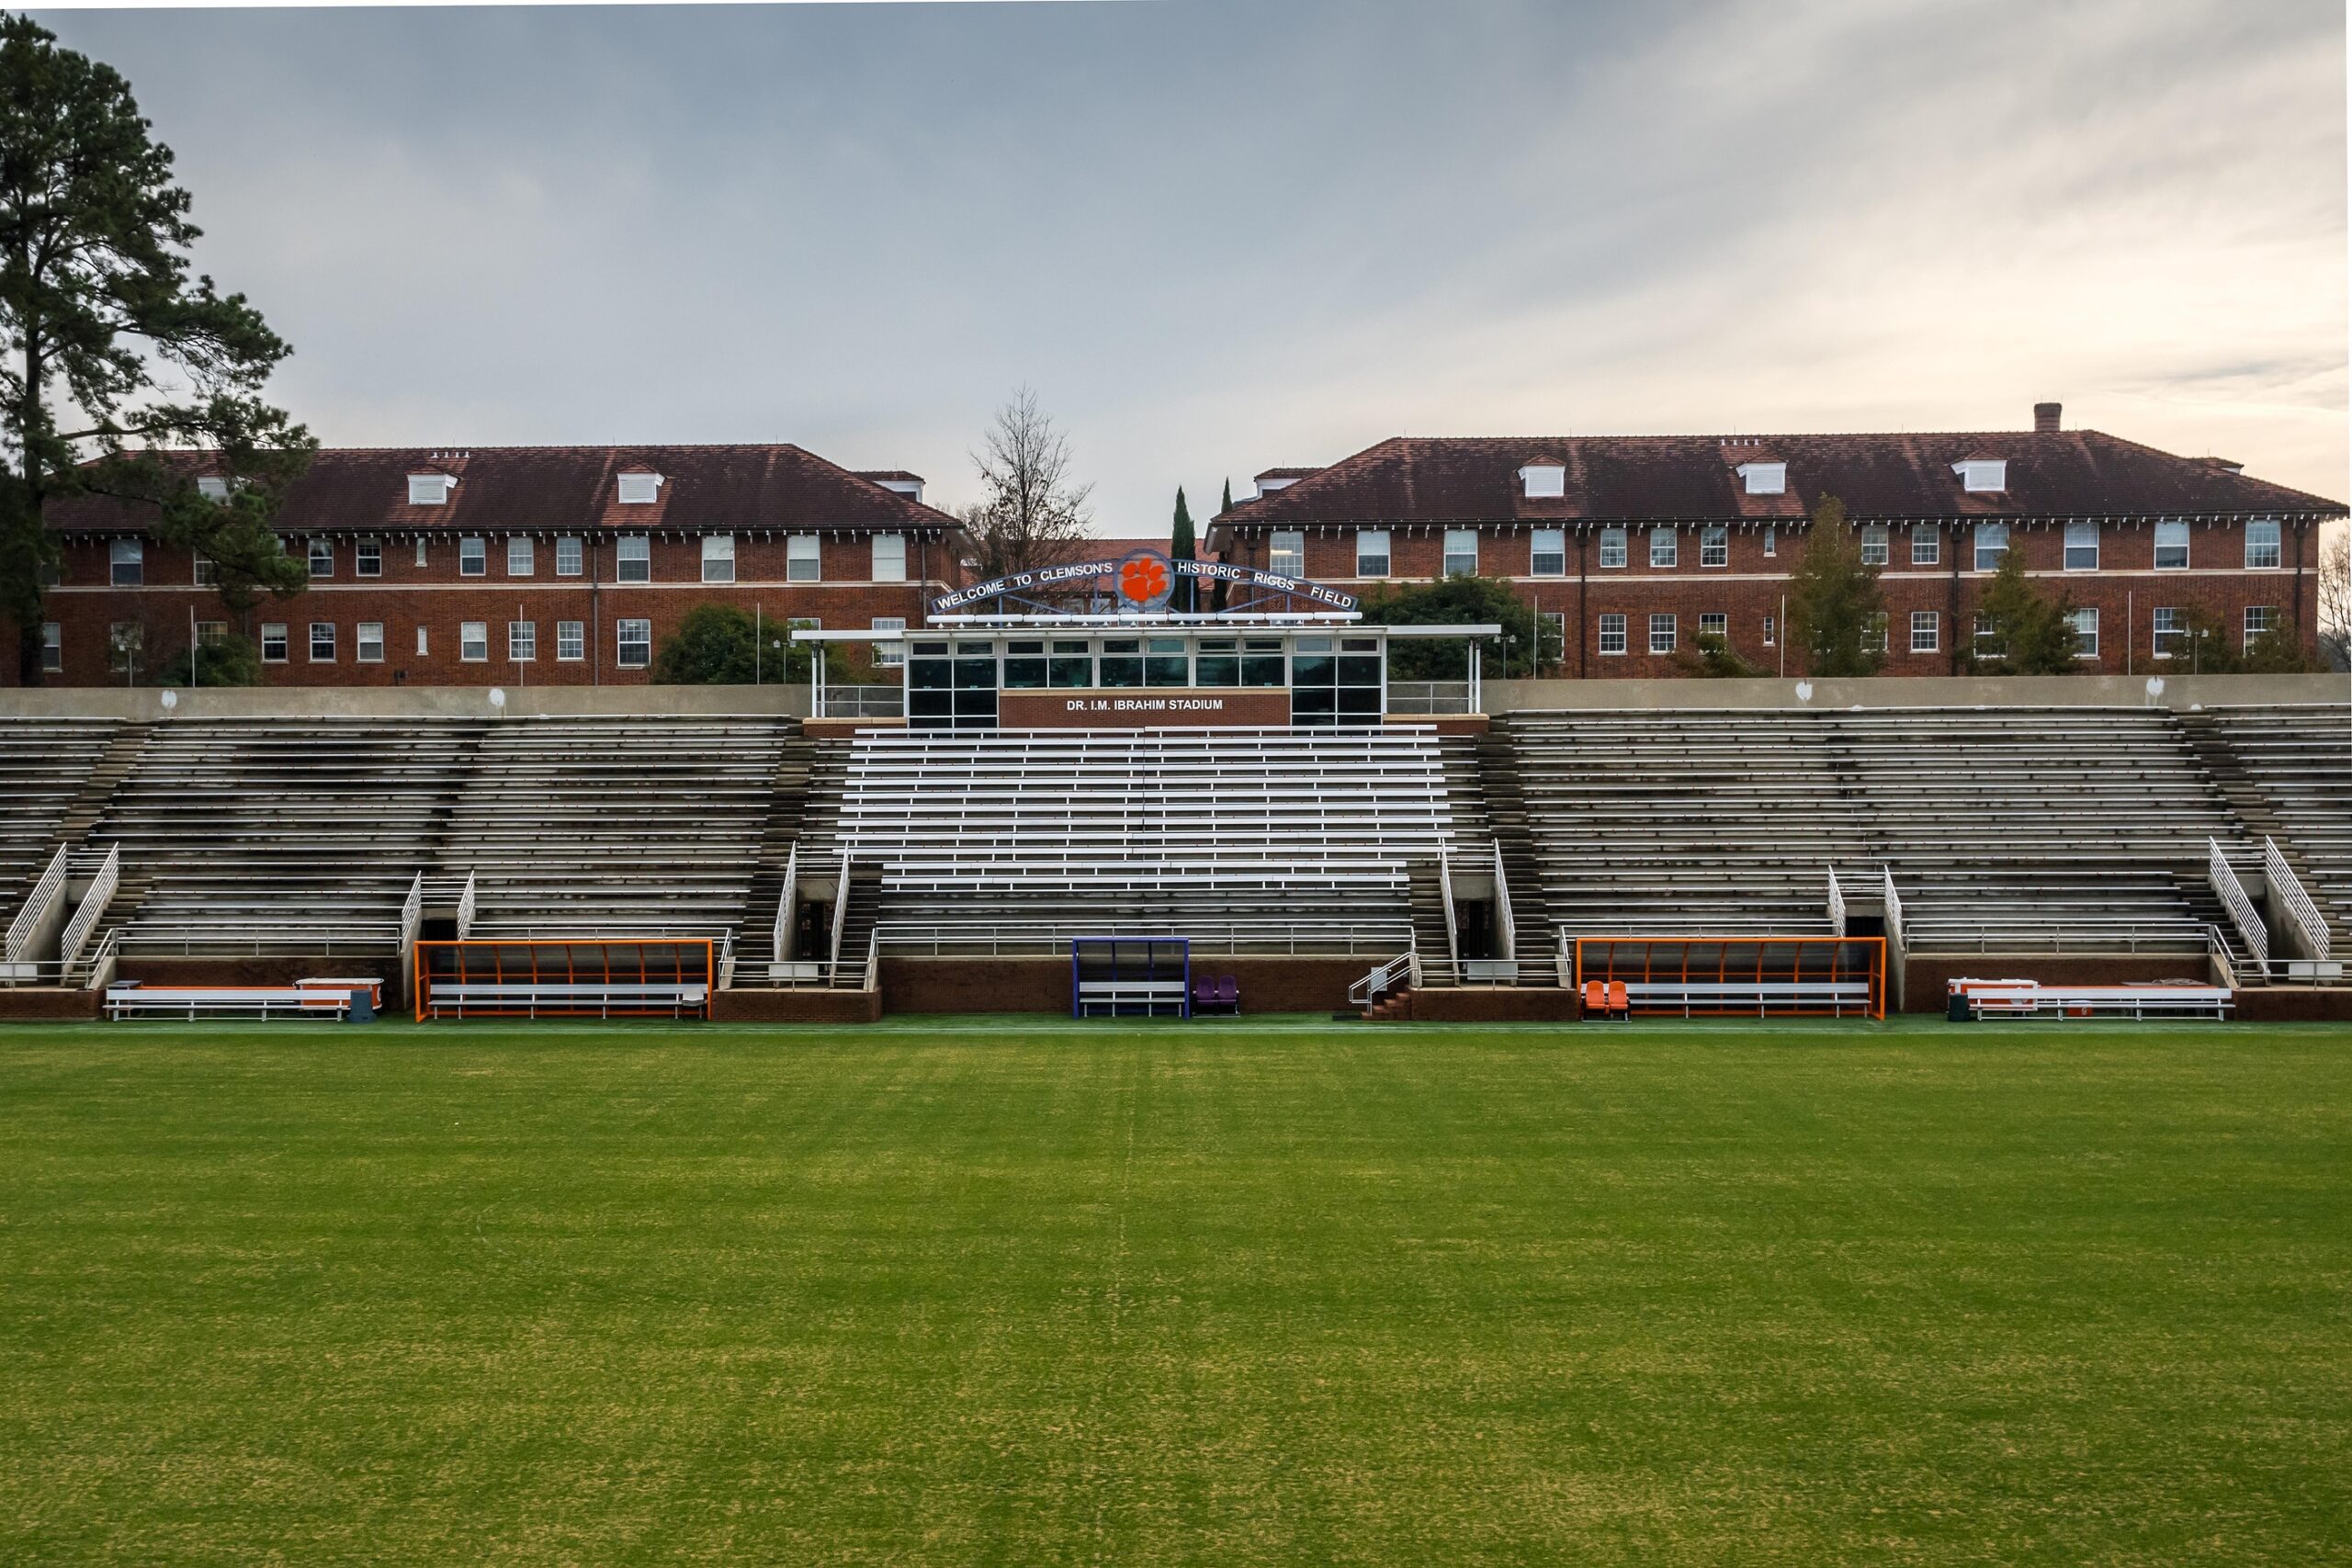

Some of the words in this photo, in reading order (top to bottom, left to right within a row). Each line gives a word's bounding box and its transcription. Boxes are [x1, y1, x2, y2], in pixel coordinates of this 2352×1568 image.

[937, 581, 1005, 610] WELCOME
[1013, 574, 1032, 587] TO
[1040, 562, 1113, 581] CLEMSON'S
[1178, 561, 1241, 579] HISTORIC
[1253, 572, 1295, 591] RIGGS
[1310, 586, 1351, 608] FIELD
[1067, 700, 1087, 711] DR.
[1091, 700, 1111, 711] I.M.
[1114, 699, 1166, 710] IBRAHIM
[1169, 699, 1223, 710] STADIUM
